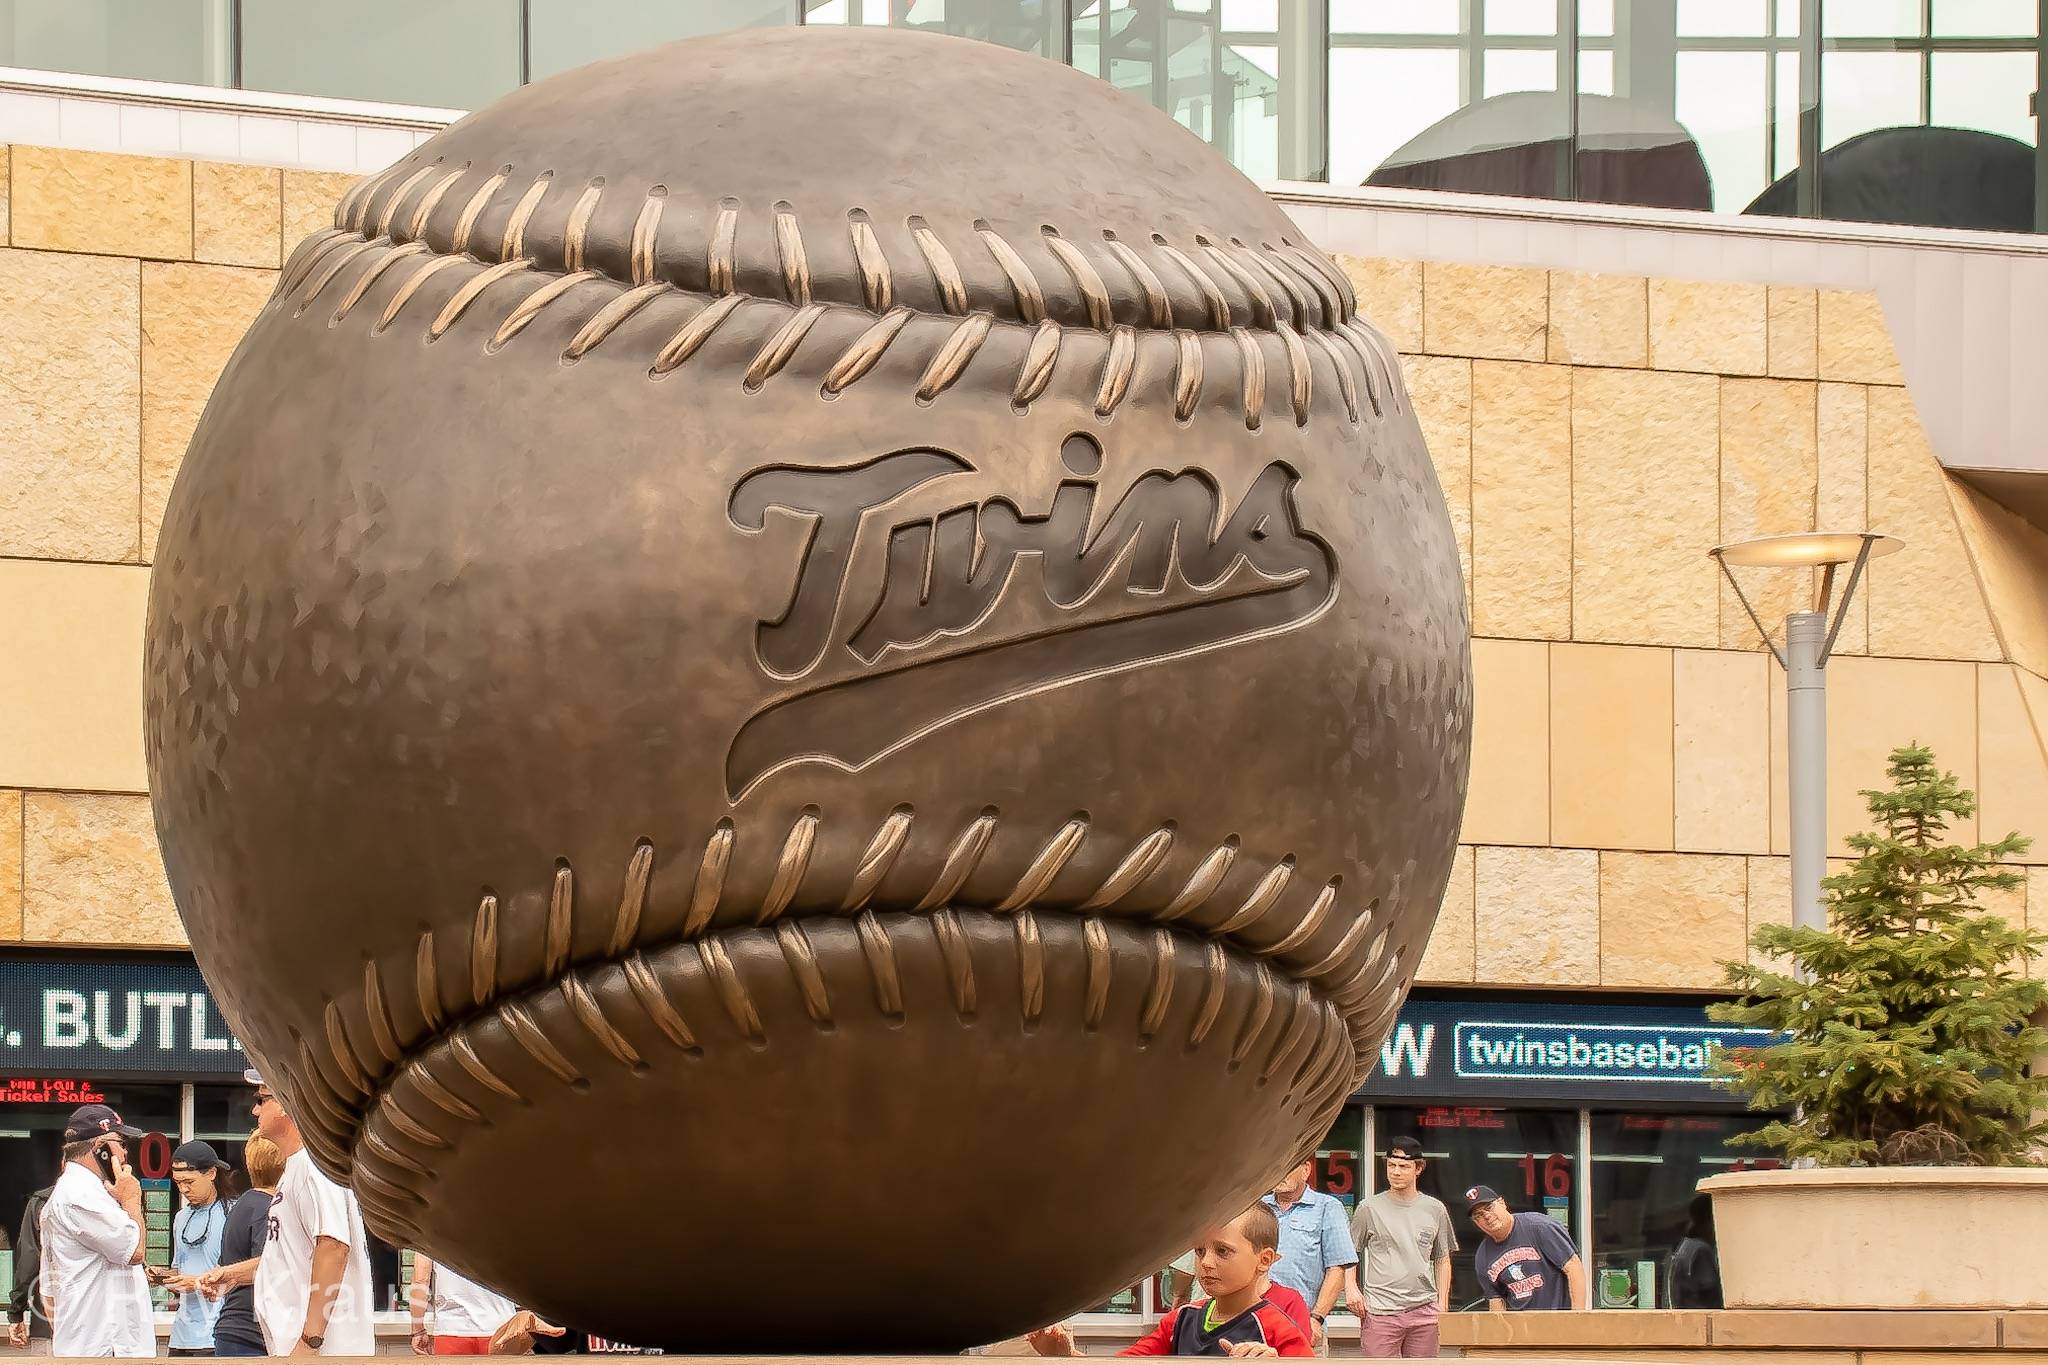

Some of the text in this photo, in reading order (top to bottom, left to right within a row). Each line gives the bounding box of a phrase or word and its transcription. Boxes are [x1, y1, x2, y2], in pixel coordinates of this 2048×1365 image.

[727, 431, 1339, 681] Twins
[43, 989, 243, 1050] BUTL
[57, 1090, 104, 1103] Sales
[1518, 1153, 1571, 1196] 16
